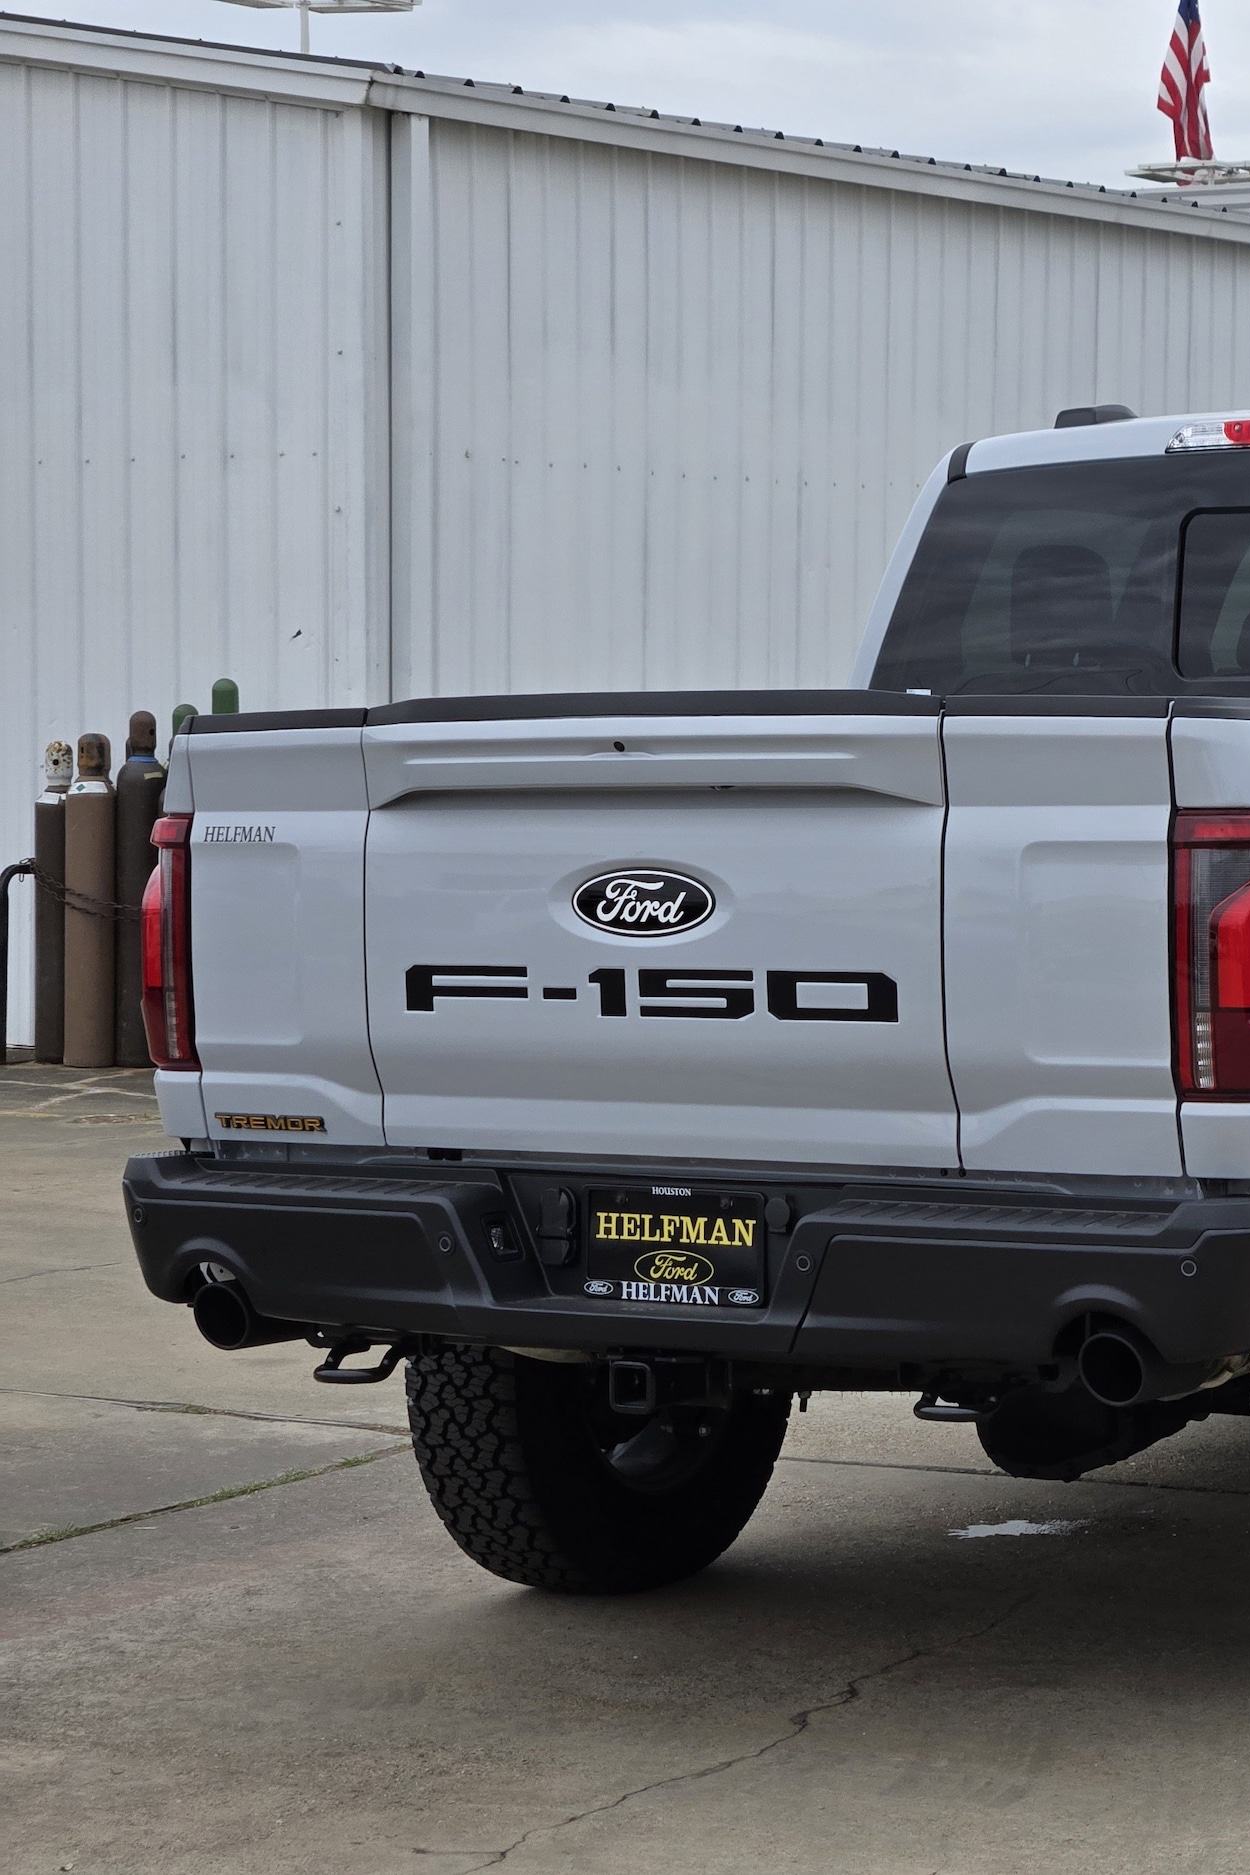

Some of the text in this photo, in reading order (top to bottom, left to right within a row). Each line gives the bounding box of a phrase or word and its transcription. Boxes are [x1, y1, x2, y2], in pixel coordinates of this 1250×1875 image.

[203, 825, 276, 843] HELFMAN
[596, 878, 685, 924] Ford
[404, 963, 900, 1024] F-150
[214, 1111, 327, 1134] TREMOR
[651, 1186, 692, 1197] HOUSTON
[596, 1211, 757, 1247] HELFMAN
[649, 1254, 699, 1281] Ford
[621, 1280, 721, 1306] HELFMAN
